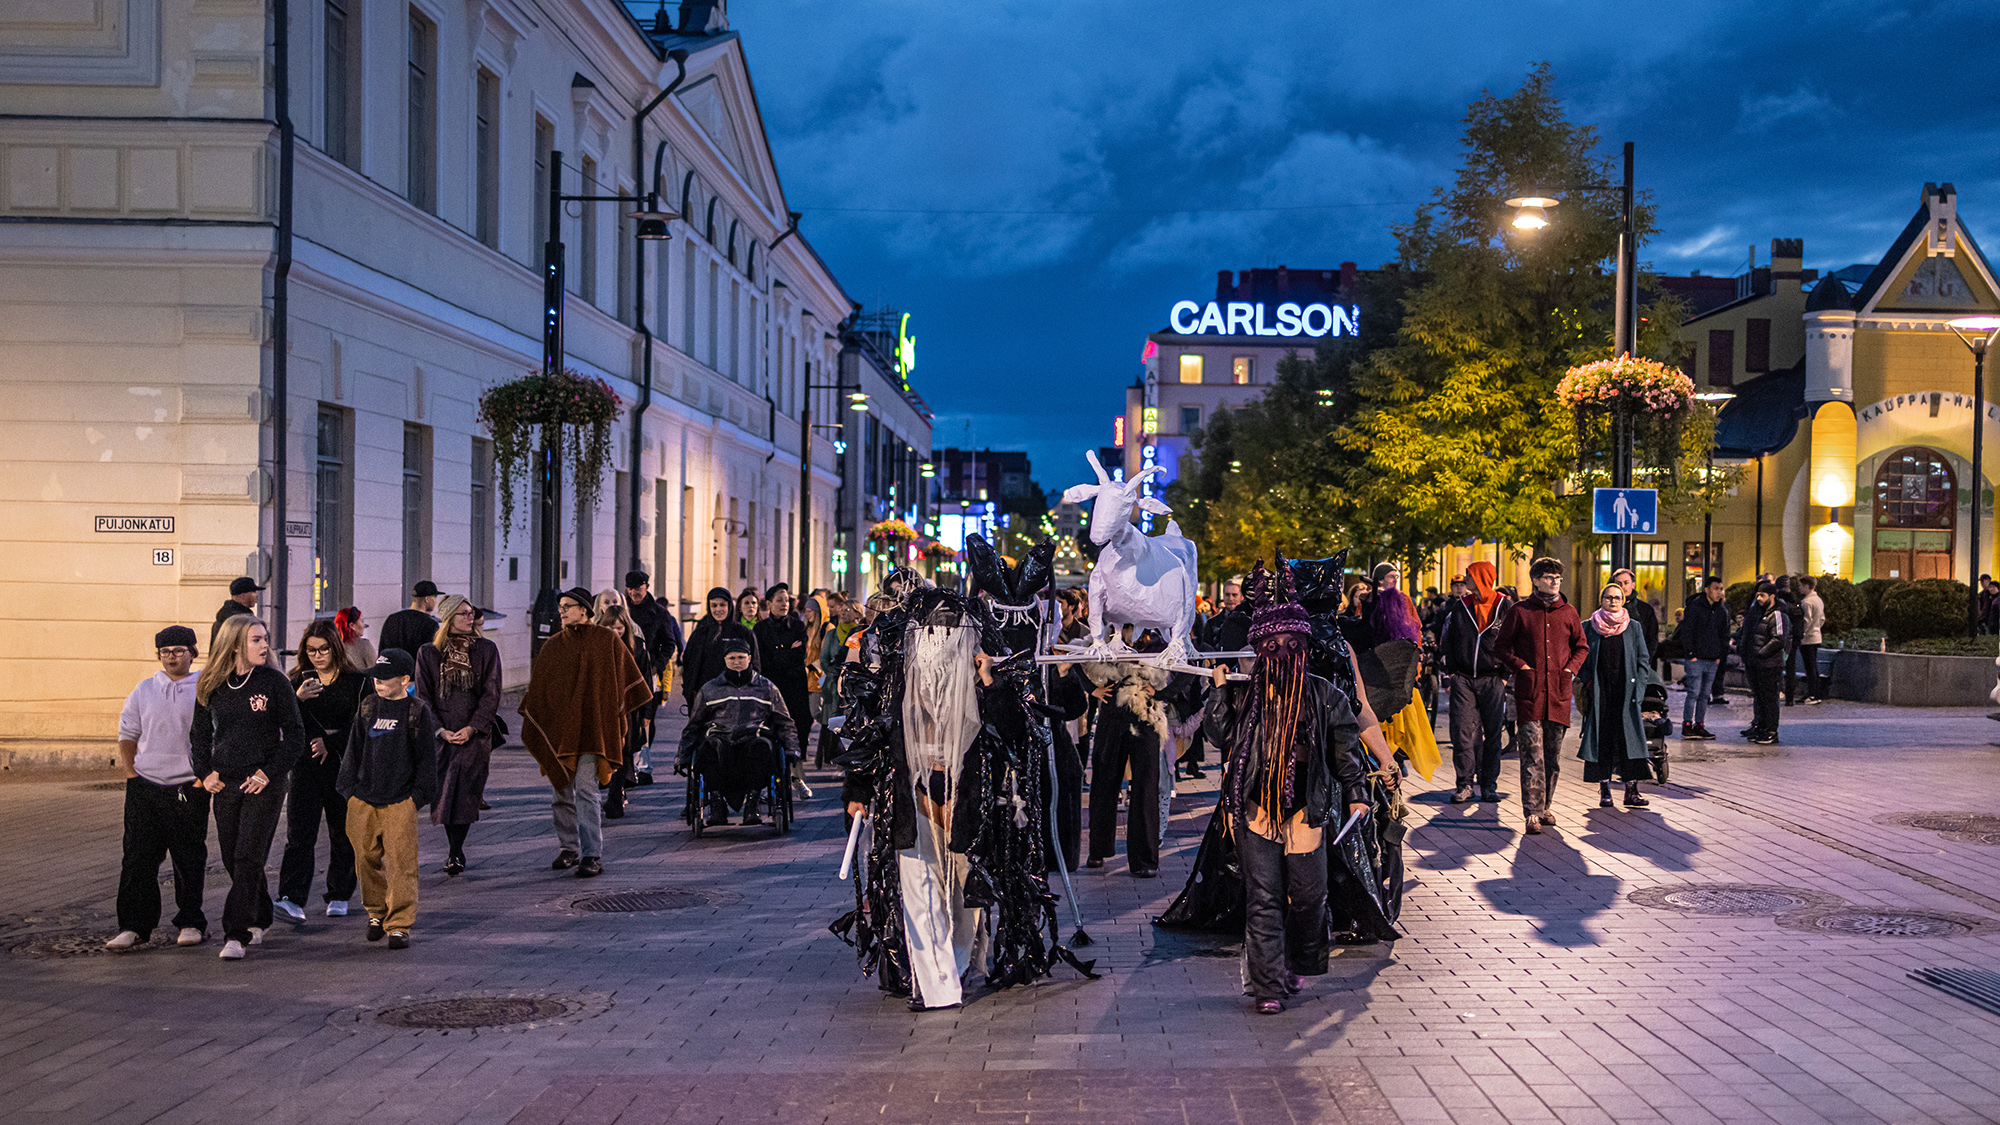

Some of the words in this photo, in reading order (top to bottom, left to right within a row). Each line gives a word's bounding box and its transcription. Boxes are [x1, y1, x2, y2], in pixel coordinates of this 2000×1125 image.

[1170, 300, 1360, 337] CARLSON
[1146, 370, 1156, 433] ATLAS
[98, 518, 171, 531] PUIJONKATU
[155, 552, 170, 563] 18
[373, 719, 398, 730] NIKE
